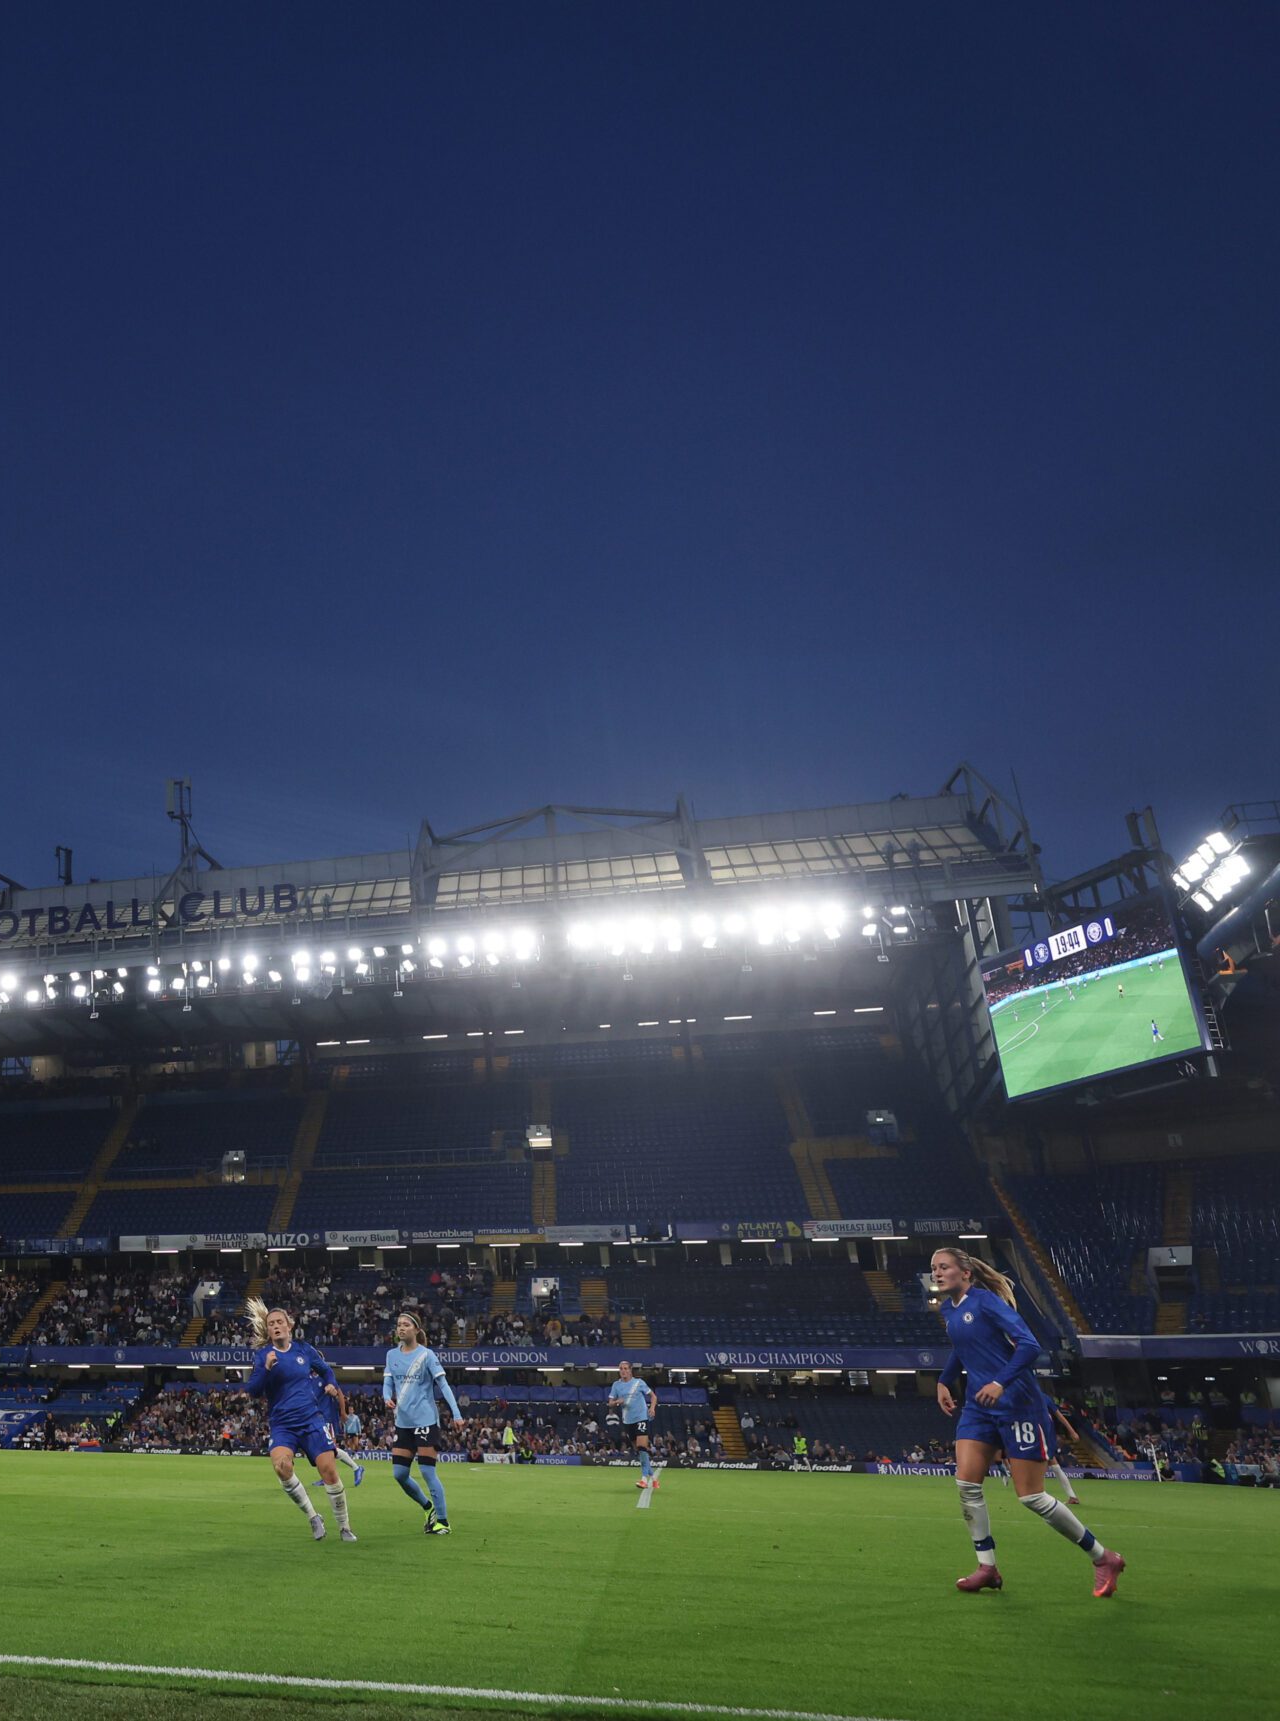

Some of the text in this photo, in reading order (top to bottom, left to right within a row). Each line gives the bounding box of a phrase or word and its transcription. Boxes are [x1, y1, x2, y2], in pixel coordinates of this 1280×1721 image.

[179, 883, 298, 922] CLUB
[1055, 930, 1081, 955] 19:44
[736, 1221, 783, 1231] ATLANTA
[866, 1222, 892, 1231] BLUES
[914, 1221, 965, 1233] AUSTIN BLUES
[342, 1232, 397, 1243] Kerry Blues
[412, 1229, 473, 1238] easternblues
[221, 1241, 249, 1249] BLUES
[267, 1233, 310, 1247] MIZO
[190, 1351, 231, 1361] WORLD
[471, 1351, 489, 1363] OF
[493, 1351, 548, 1363] LONDON
[705, 1352, 844, 1365] WORLD CHAMPIONS
[637, 1422, 647, 1430] 22
[1010, 1420, 1036, 1444] 18
[719, 1462, 758, 1470] football
[811, 1464, 853, 1472] football
[889, 1465, 952, 1476] Museum
